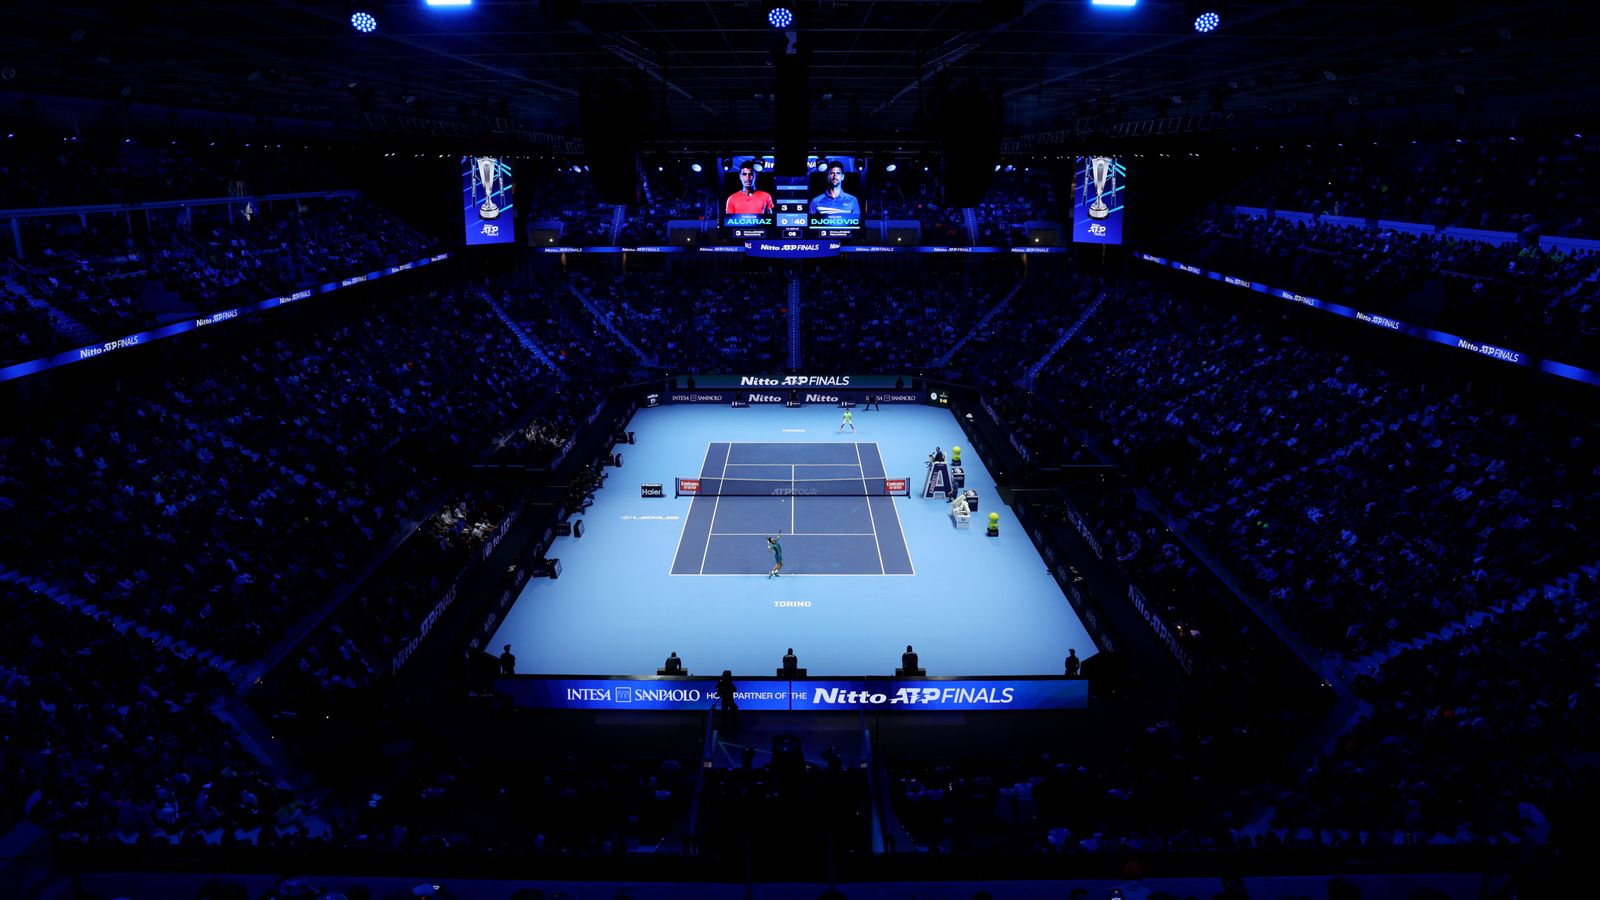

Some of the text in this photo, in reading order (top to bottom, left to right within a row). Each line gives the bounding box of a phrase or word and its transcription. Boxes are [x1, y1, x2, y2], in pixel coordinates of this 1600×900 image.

[196, 319, 212, 327] Nitto
[222, 310, 238, 319] FINALS
[1382, 318, 1400, 329] FINALS
[80, 336, 138, 358] Nitto ATP FINALS
[1458, 339, 1519, 363] Nitto ATP FINALS
[741, 376, 850, 385] Nitto ATP FINALS
[748, 394, 781, 402] Nitto
[806, 394, 838, 402] Nitto
[1128, 584, 1150, 621] Nitto
[567, 688, 611, 700] INTESA
[635, 688, 700, 701] SANPAOLO
[789, 692, 807, 700] THE
[813, 688, 887, 704] Nitto
[888, 688, 940, 704] ATP
[942, 688, 1014, 703] FINALS
